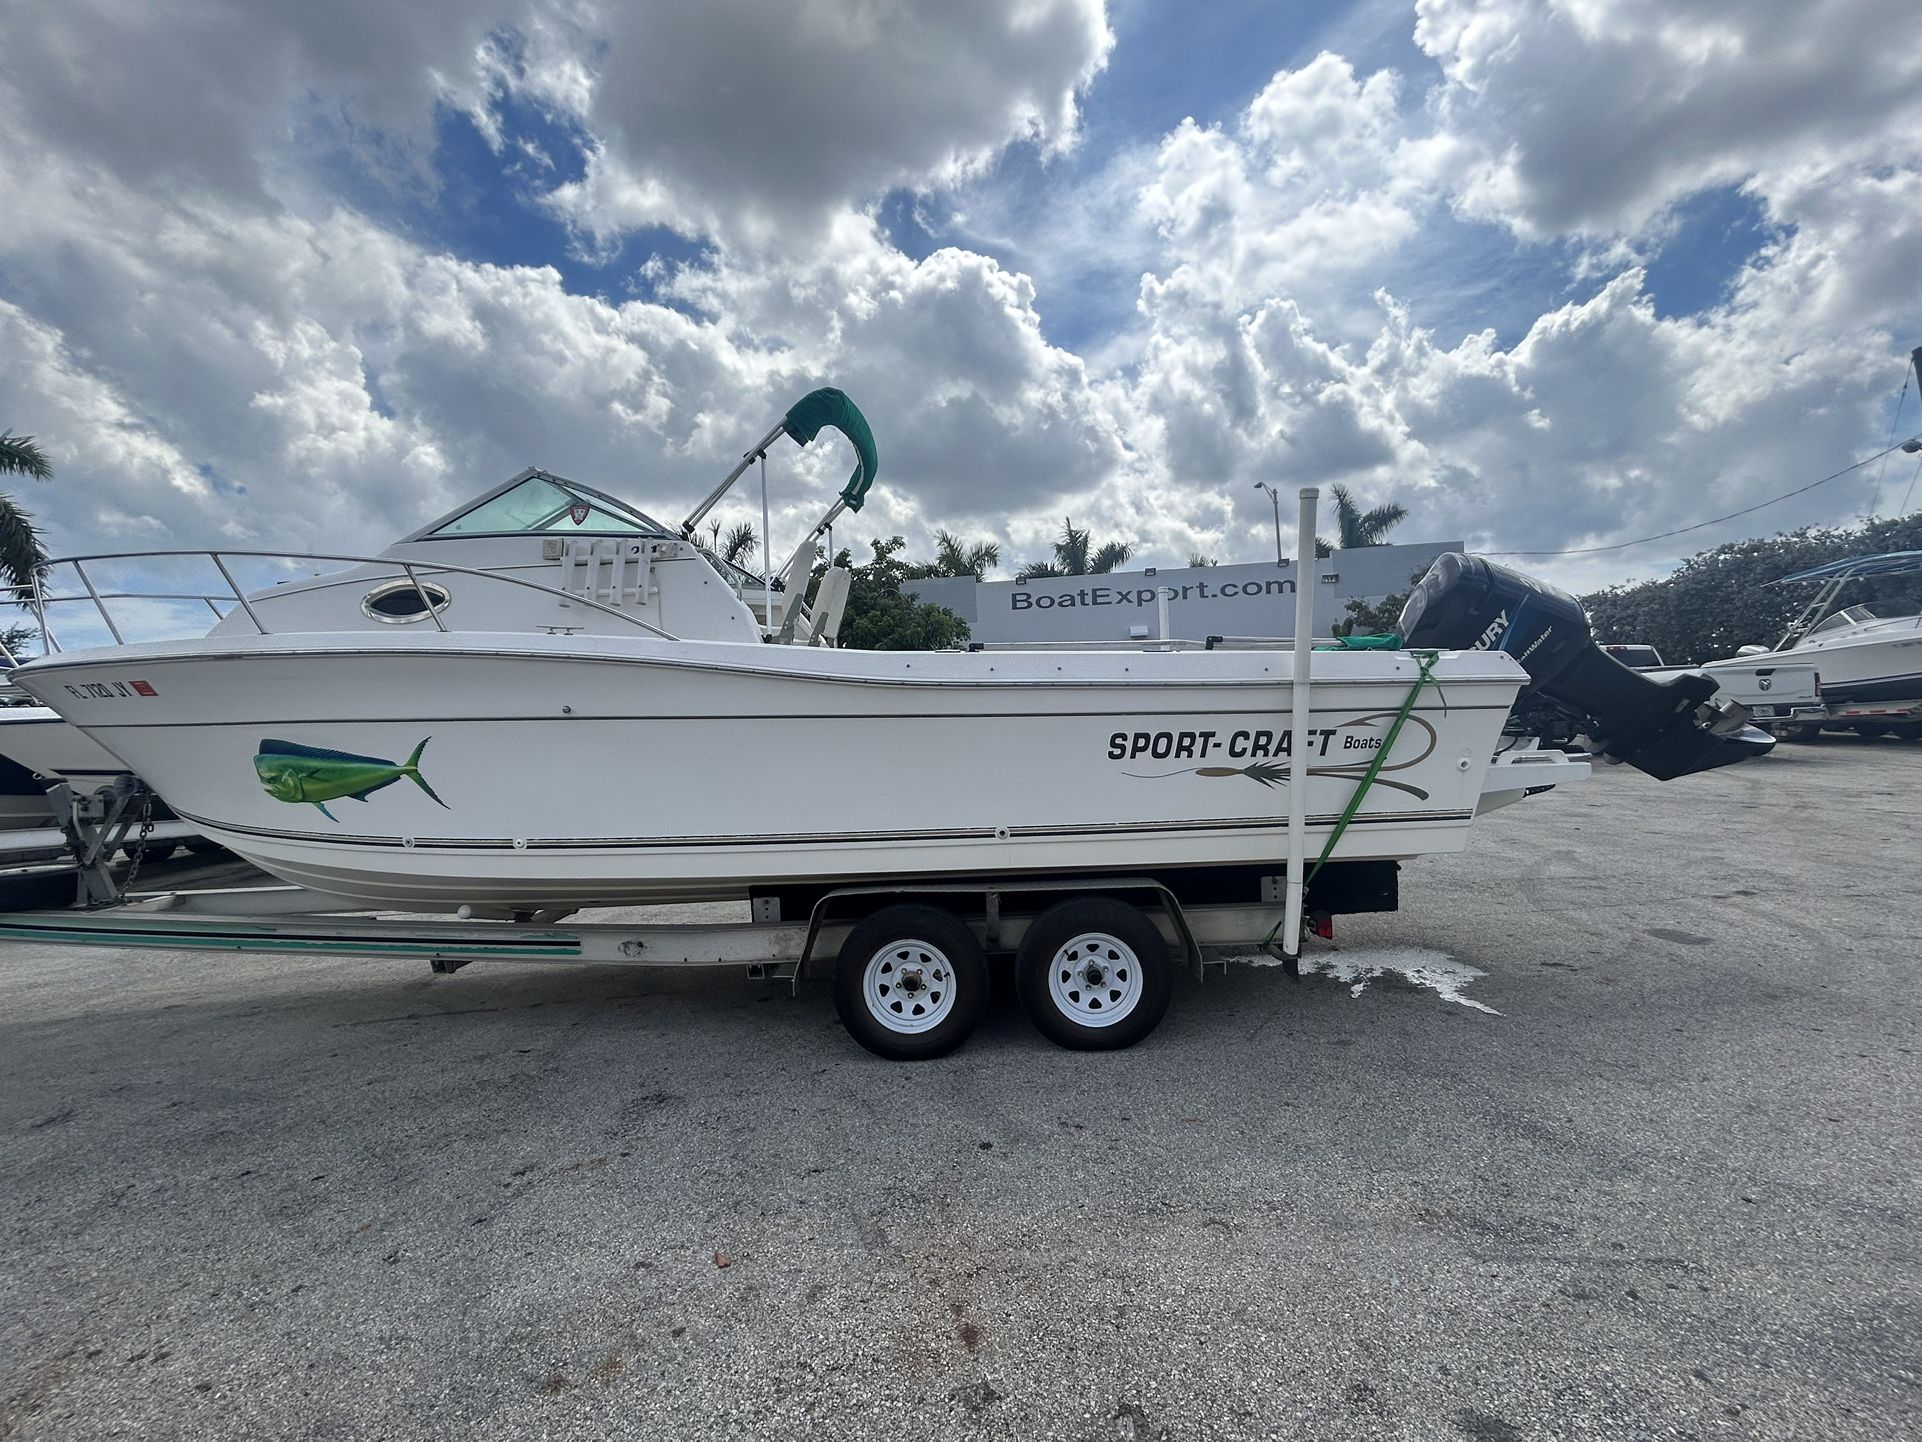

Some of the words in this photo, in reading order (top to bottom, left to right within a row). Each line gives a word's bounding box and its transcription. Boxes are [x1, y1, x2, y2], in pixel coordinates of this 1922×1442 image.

[1011, 579, 1296, 610] BoatExport.com
[1469, 609, 1509, 650] URY
[64, 685, 88, 699] FL
[1343, 735, 1382, 749] Boats
